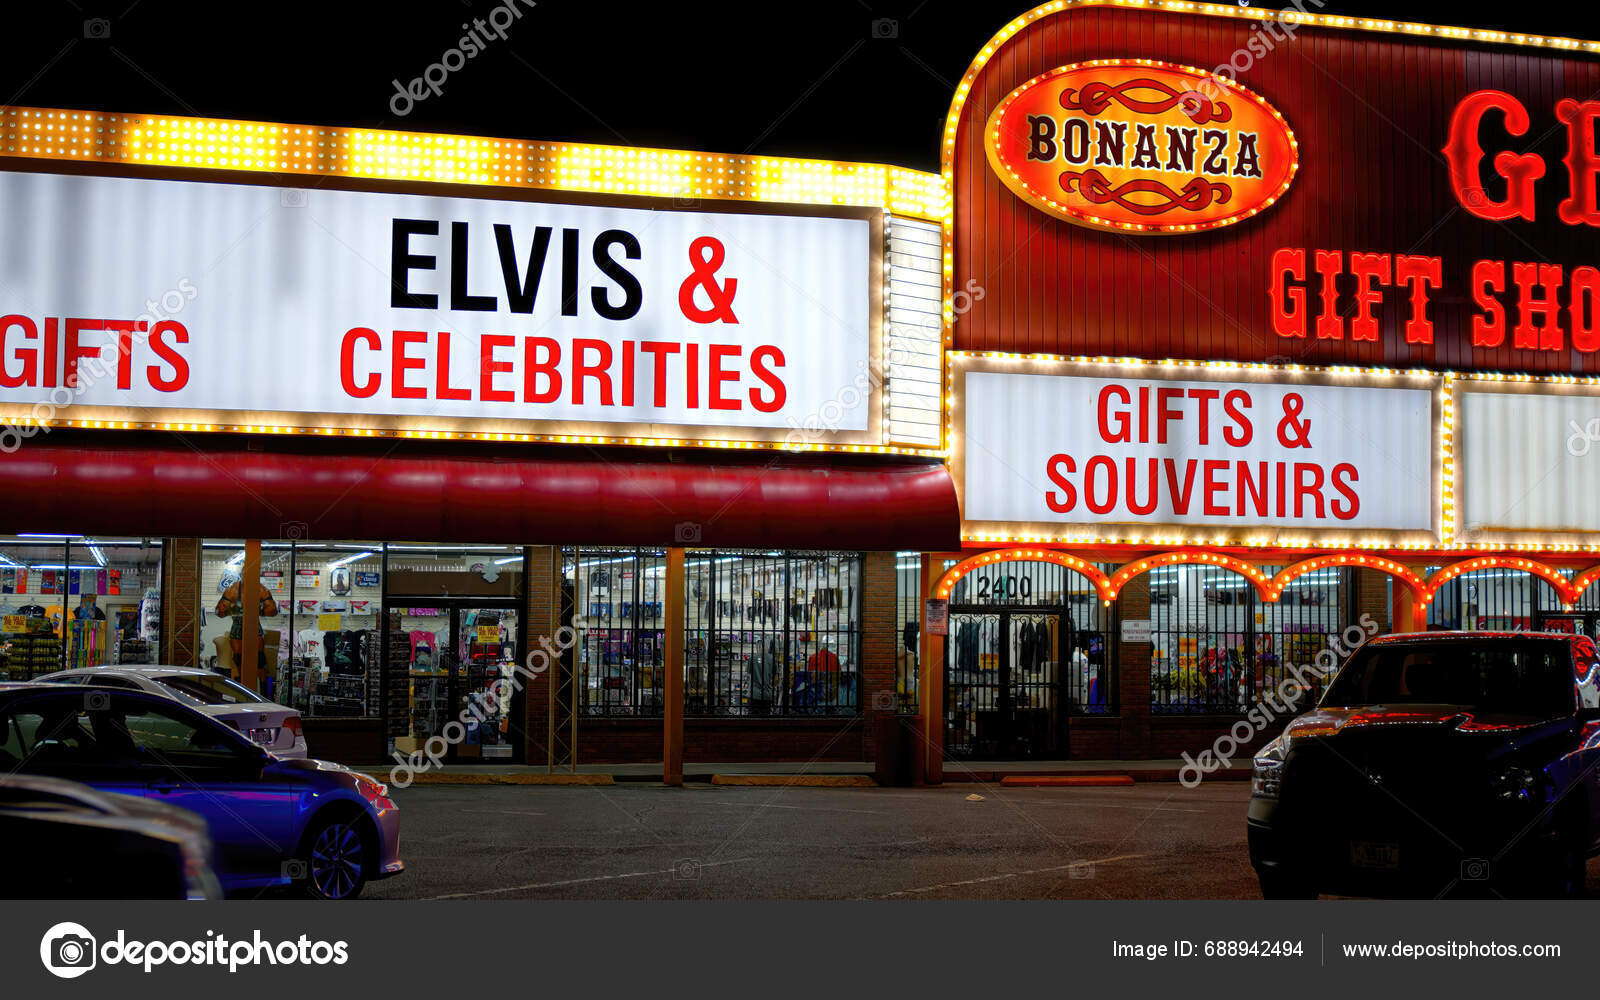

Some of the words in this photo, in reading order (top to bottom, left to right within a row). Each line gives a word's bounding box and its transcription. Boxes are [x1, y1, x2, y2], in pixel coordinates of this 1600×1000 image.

[1026, 114, 1263, 179] BONANZA
[390, 217, 643, 321] ELVIS
[678, 236, 739, 324] &
[1269, 247, 1443, 345] GIFT
[1472, 260, 1600, 353] SHO
[0, 314, 190, 393] GIFTS
[340, 326, 787, 413] CELEBRITIES
[1097, 384, 1254, 448] GIFTS
[1276, 392, 1312, 449] &
[1045, 453, 1360, 520] SOUVENIRS
[977, 576, 1032, 598] 2400
